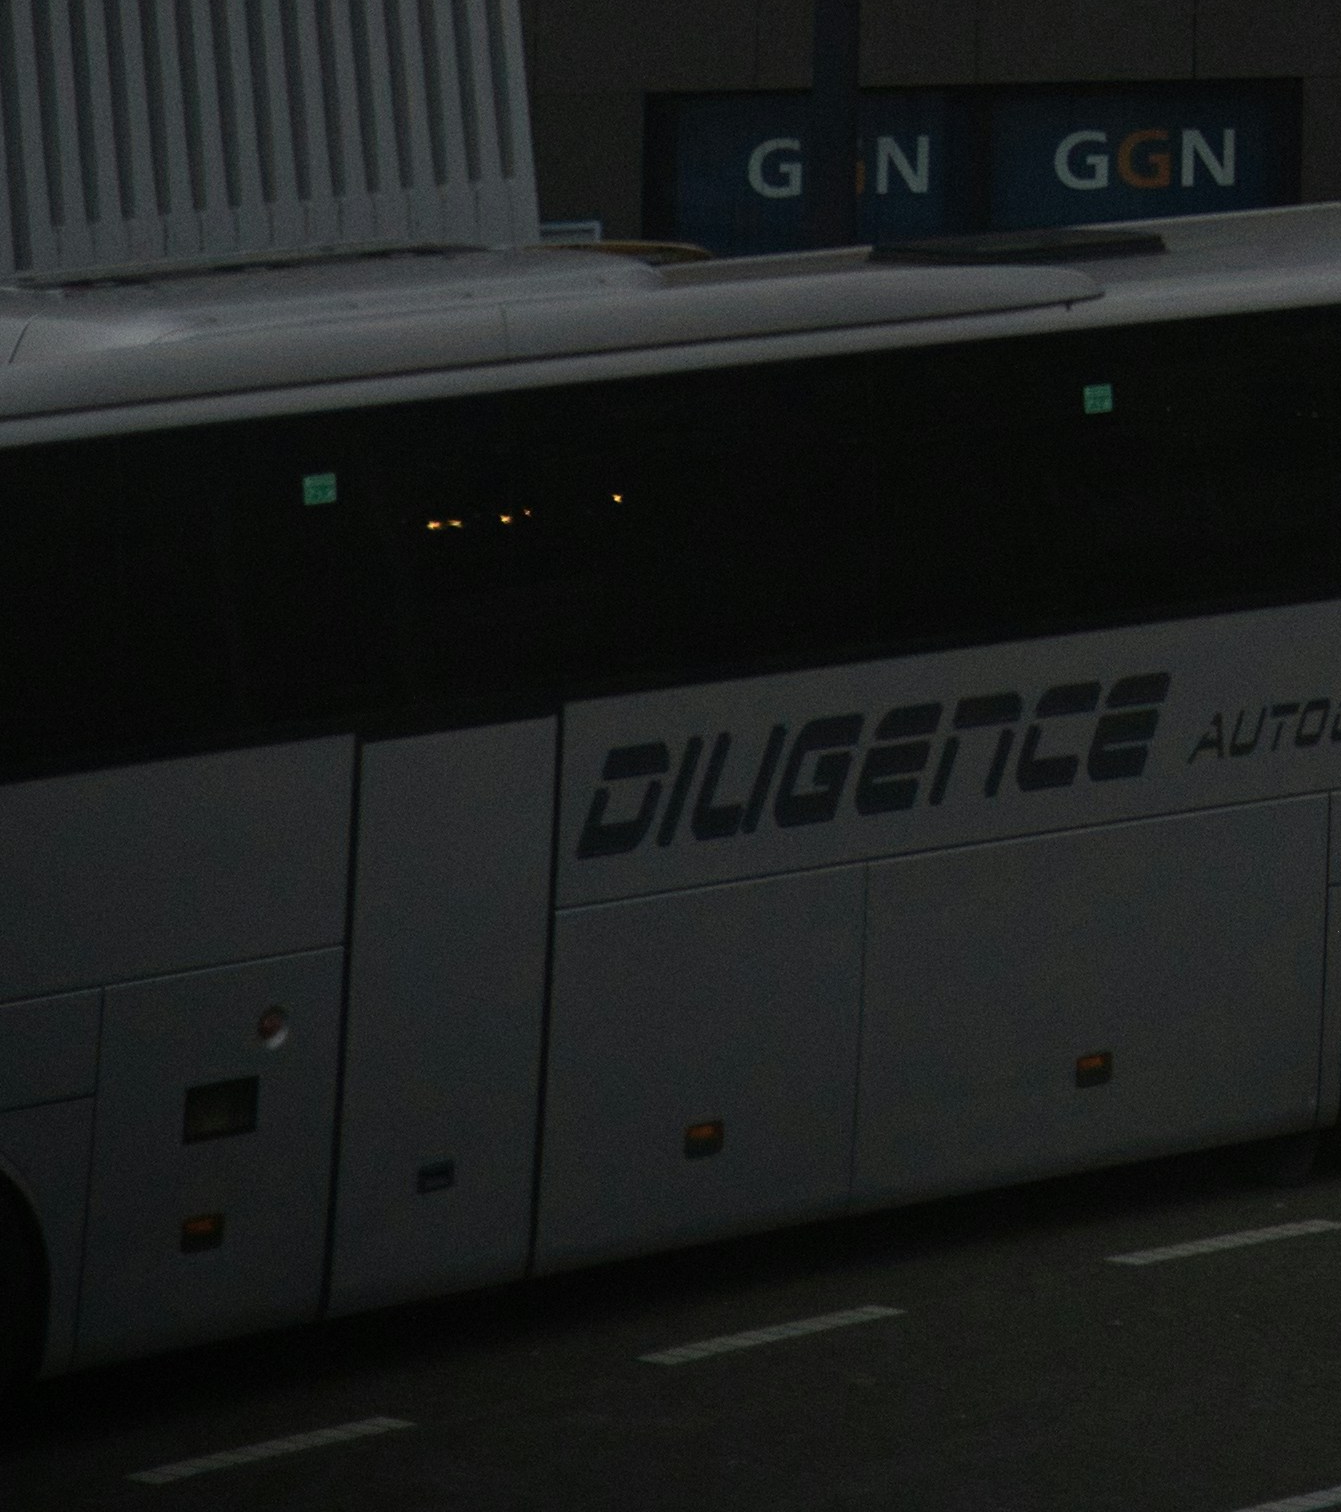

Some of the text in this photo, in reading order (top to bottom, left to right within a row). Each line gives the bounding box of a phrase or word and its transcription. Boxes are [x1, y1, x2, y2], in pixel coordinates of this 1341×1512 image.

[748, 135, 929, 199] GN
[1053, 128, 1236, 190] GGN
[576, 671, 1171, 861] DILIGENCE
